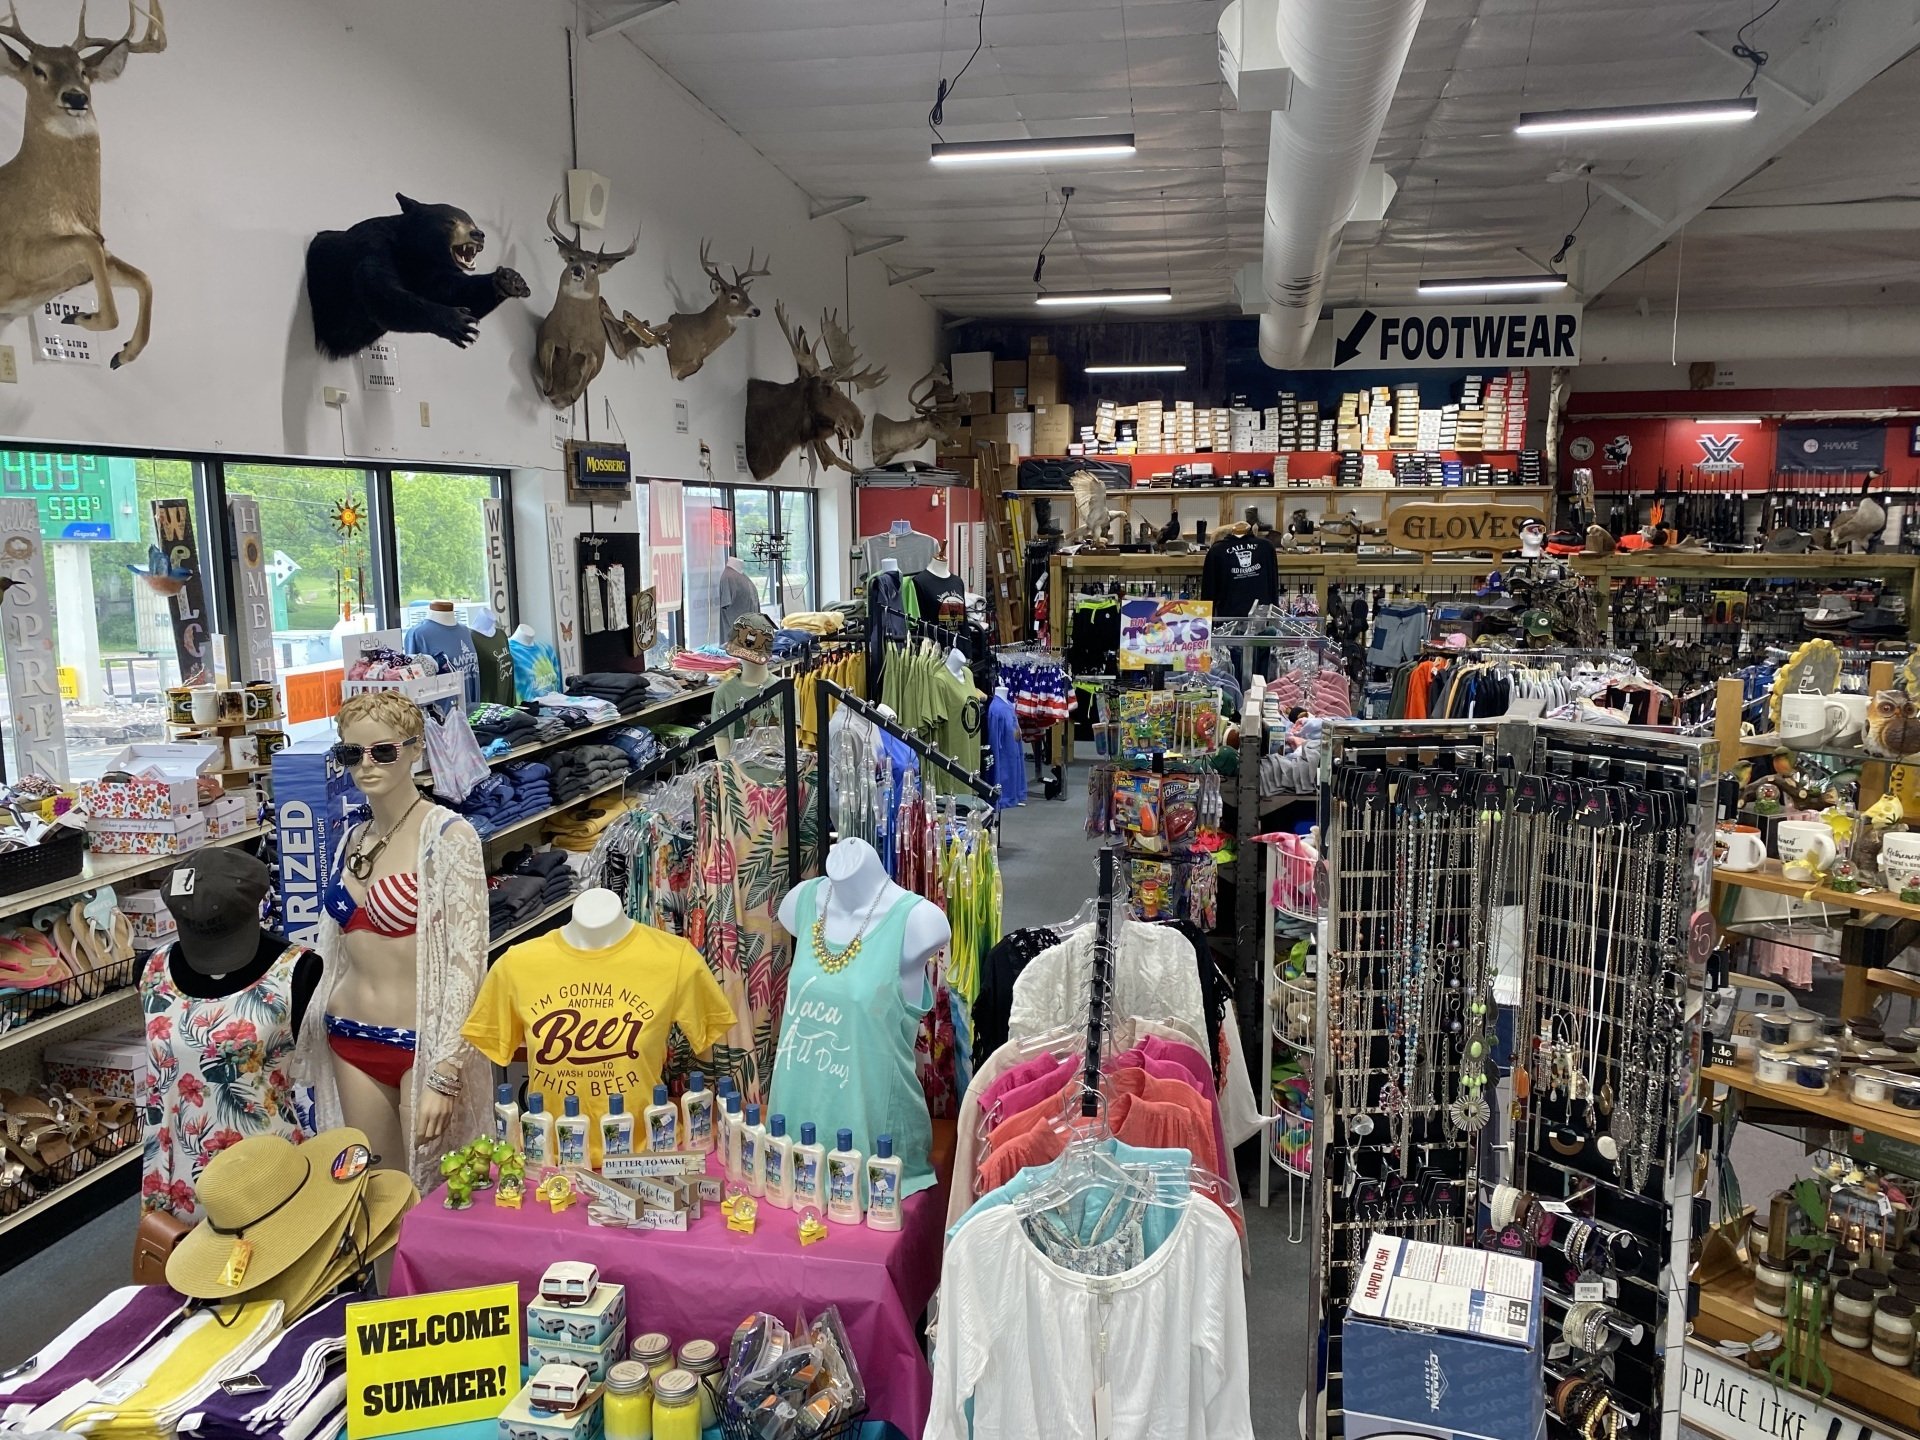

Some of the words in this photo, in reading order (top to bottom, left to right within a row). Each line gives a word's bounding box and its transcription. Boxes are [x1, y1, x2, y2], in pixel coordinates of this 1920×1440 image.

[45, 303, 80, 316] BUCK
[1379, 314, 1577, 361] FOOTWEAR
[586, 456, 626, 472] MOSSBERG
[48, 496, 91, 520] 539
[1403, 511, 1523, 540] GLOVES
[1145, 646, 1161, 655] FOR
[1164, 644, 1178, 653] ALL
[1181, 640, 1209, 652] AGES!!
[320, 838, 329, 888] HORIZONTAL
[530, 993, 553, 1015] I'M
[559, 982, 613, 999] GONNA
[618, 988, 655, 1021] NEED
[567, 998, 614, 1009] ANOTHER
[785, 975, 842, 1025] Vaca
[531, 1008, 644, 1066] Beer
[557, 1070, 583, 1078] WASH
[587, 1070, 615, 1078] DOWN
[601, 1061, 614, 1070] TO
[814, 1046, 849, 1089] Day
[533, 1068, 577, 1096] THIS
[590, 1070, 640, 1097] BEER
[605, 1158, 643, 1168] BETTER
[645, 1158, 658, 1167] TO
[659, 1157, 687, 1166] WAKE
[624, 1168, 635, 1176] the
[1373, 1248, 1391, 1273] PUSH
[1364, 1271, 1384, 1300] RAPID
[356, 1305, 510, 1356] WELCOME
[363, 1365, 507, 1417] SUMMER!
[1693, 1367, 1749, 1422] PLACE
[1758, 1397, 1808, 1440] LIKE
